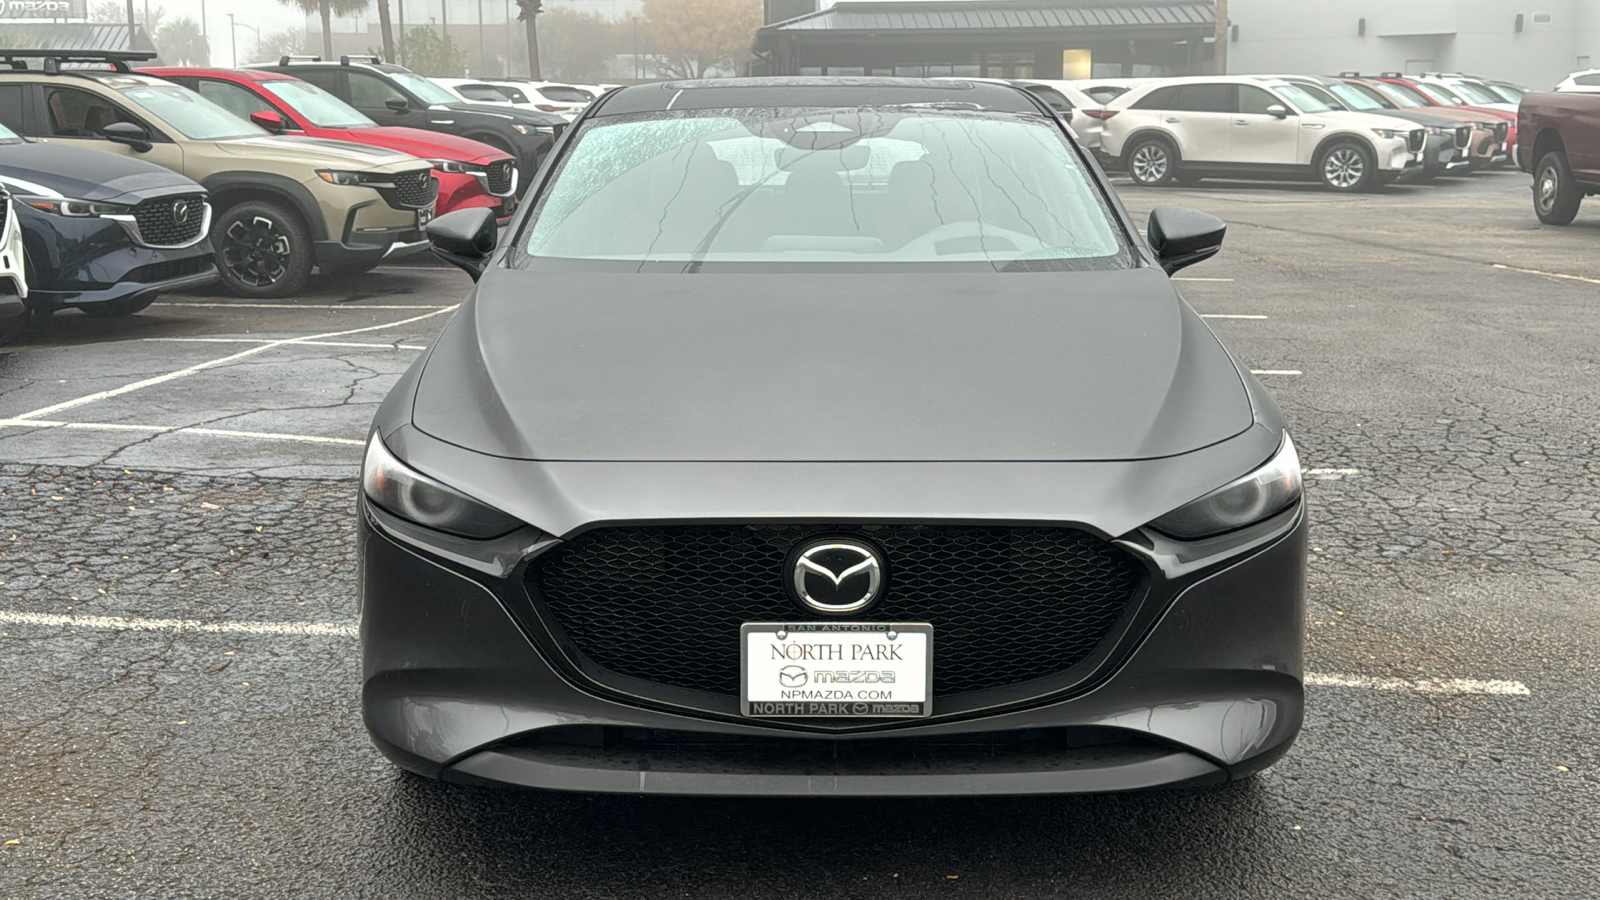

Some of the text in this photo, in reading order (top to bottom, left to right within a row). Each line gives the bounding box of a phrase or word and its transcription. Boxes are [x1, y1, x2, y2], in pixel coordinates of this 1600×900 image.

[770, 643, 904, 661] NORTH PARK
[813, 670, 896, 684] mazda
[781, 690, 892, 700] NPMAZDA.COM
[753, 703, 920, 714] NORTH PARK mazda
